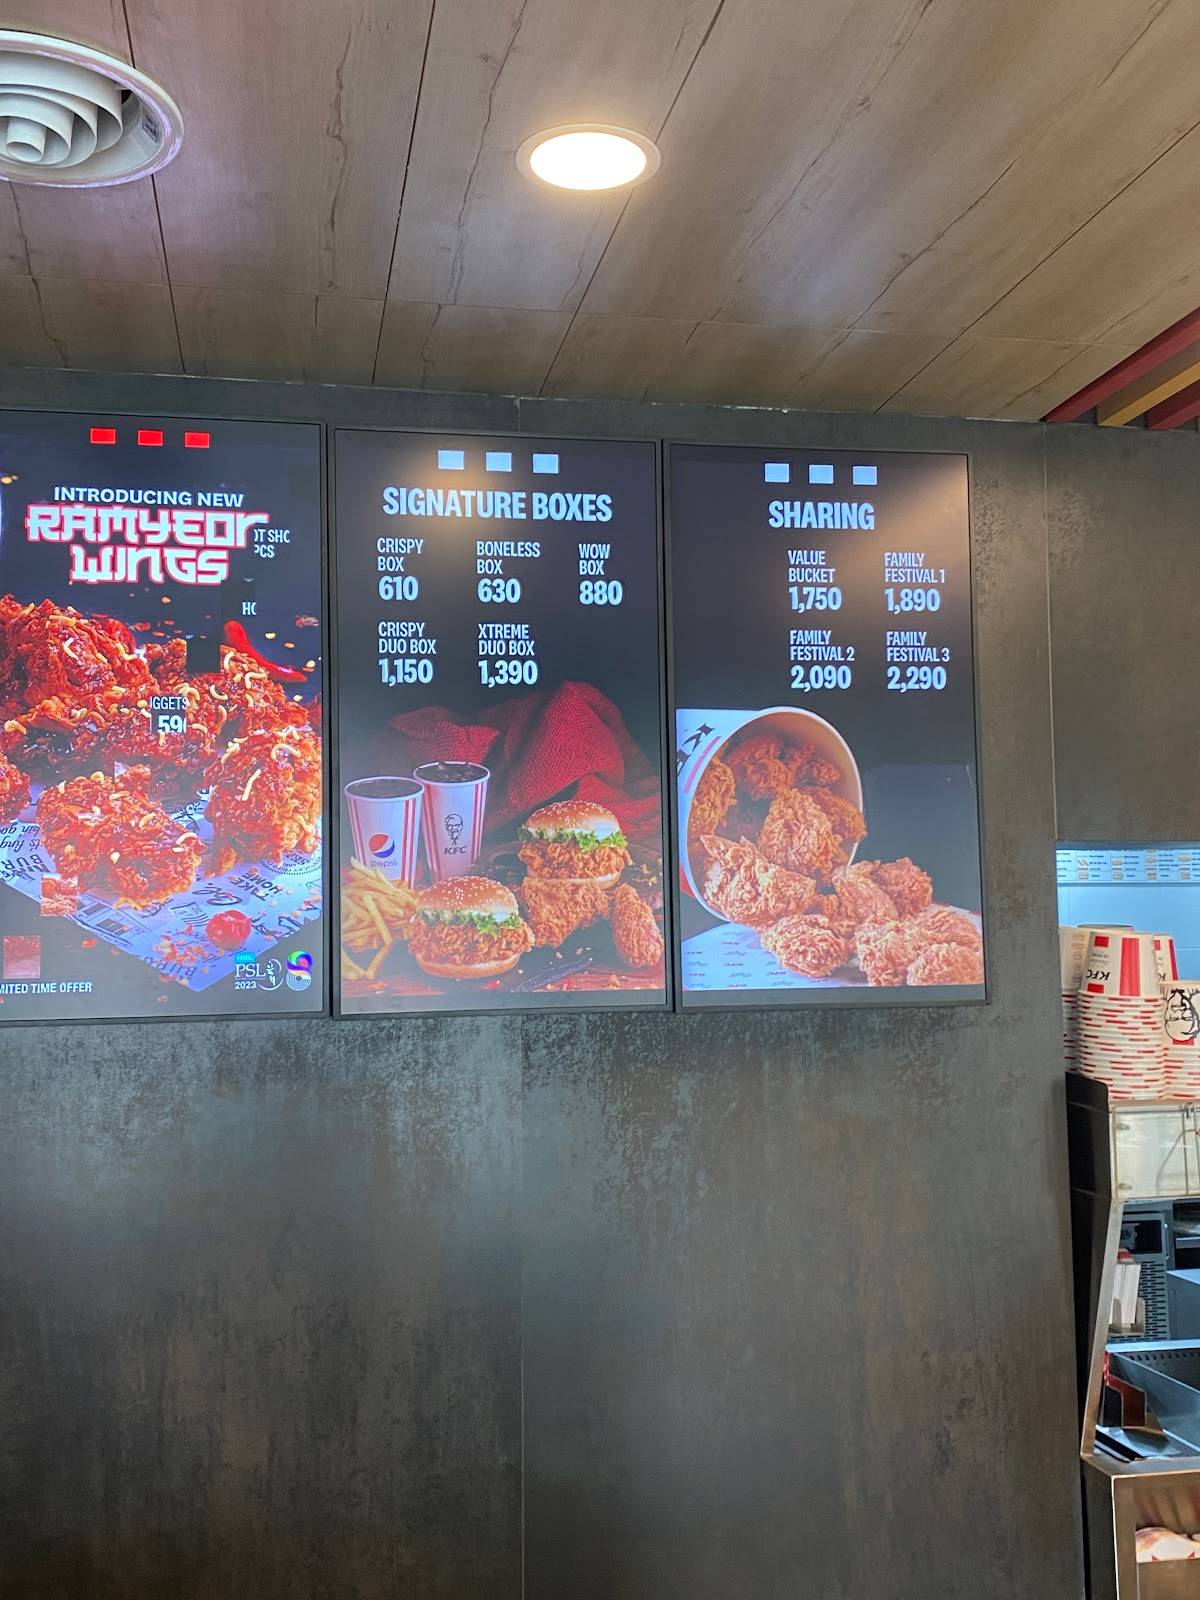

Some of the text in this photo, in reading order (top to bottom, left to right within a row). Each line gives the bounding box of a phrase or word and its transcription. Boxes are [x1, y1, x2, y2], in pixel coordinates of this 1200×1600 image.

[54, 486, 244, 508] INTRODUCING NEW
[382, 486, 612, 522] SIGNATURE BOXES
[768, 500, 875, 530] SHARING
[376, 537, 423, 554] CRISPY
[476, 541, 541, 558] BONELESS
[579, 543, 611, 560] WOW
[69, 543, 230, 585] WINGS
[377, 556, 404, 572] BOX
[787, 550, 826, 565] VALUE
[884, 552, 924, 567] FAMILY
[476, 559, 503, 575] BOX
[579, 560, 605, 576] BOX
[788, 568, 835, 583] BUCKET
[884, 568, 945, 583] FESTIVAL 1
[378, 576, 419, 601] 610
[477, 578, 521, 603] 630
[578, 580, 623, 606] 880
[788, 586, 842, 613] 1,750
[884, 588, 940, 614] 1,890
[378, 622, 425, 638] CRISPY
[478, 624, 529, 639] XTREME
[789, 630, 831, 645] FAMILY
[886, 631, 927, 646] FAMILY
[378, 639, 437, 655] DUO BOX
[478, 640, 535, 656] DUO BOX
[790, 646, 855, 661] FESTIVAL 2
[886, 647, 950, 662] FESTIVAL 3
[378, 658, 434, 687] 1,150
[478, 660, 538, 688] 1,390
[790, 665, 852, 692] 2,090
[886, 666, 947, 692] 2,290
[158, 714, 187, 733] 59
[443, 846, 467, 855] KFC
[241, 872, 284, 895] HOME
[235, 963, 266, 978] PSL
[1086, 969, 1111, 981] KFC
[30, 982, 57, 994] TIME
[59, 981, 92, 993] OFFER
[234, 981, 257, 990] 2023
